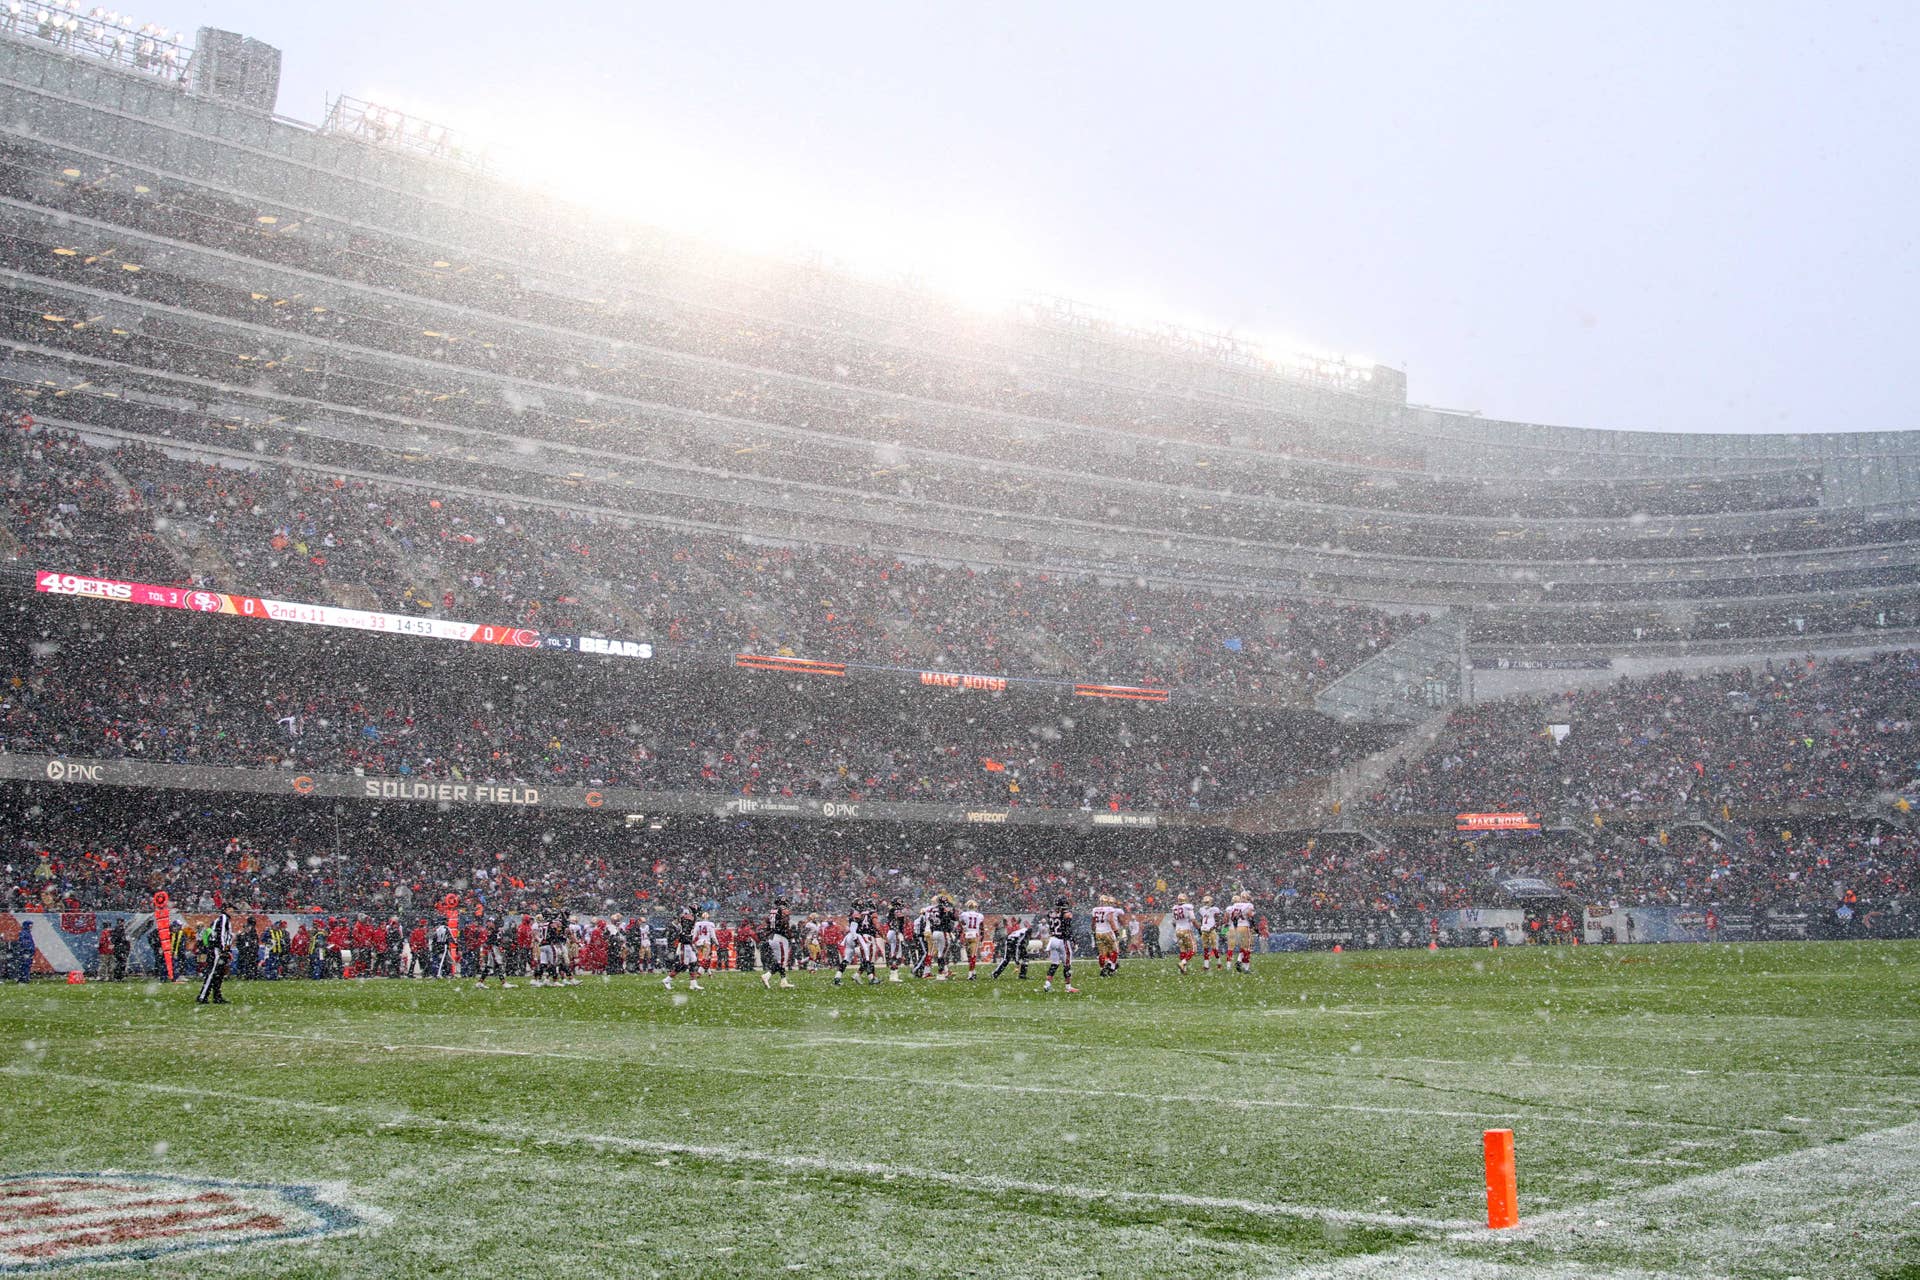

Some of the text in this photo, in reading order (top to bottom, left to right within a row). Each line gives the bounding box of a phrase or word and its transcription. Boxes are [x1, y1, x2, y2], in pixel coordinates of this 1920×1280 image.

[40, 573, 177, 603] 49ERS TOL 3
[243, 599, 254, 614] 0
[271, 604, 297, 619] 2nd
[310, 608, 325, 622] 11
[370, 615, 385, 628] 33
[396, 619, 432, 634] 14:53
[460, 626, 467, 638] 2
[484, 628, 493, 641] 0
[548, 637, 652, 658] TOL 3 BEARS
[920, 672, 1007, 691] MAKE NOISE
[68, 763, 103, 781] PNC
[366, 780, 539, 804] SOLDIER FIELD
[836, 804, 859, 817] PNC
[967, 810, 1005, 823] verizon
[1094, 813, 1123, 824] WBBM
[1468, 816, 1529, 826] MAKE NOISE
[968, 916, 977, 929] 11
[1094, 911, 1105, 923] 67
[699, 925, 708, 936] 14
